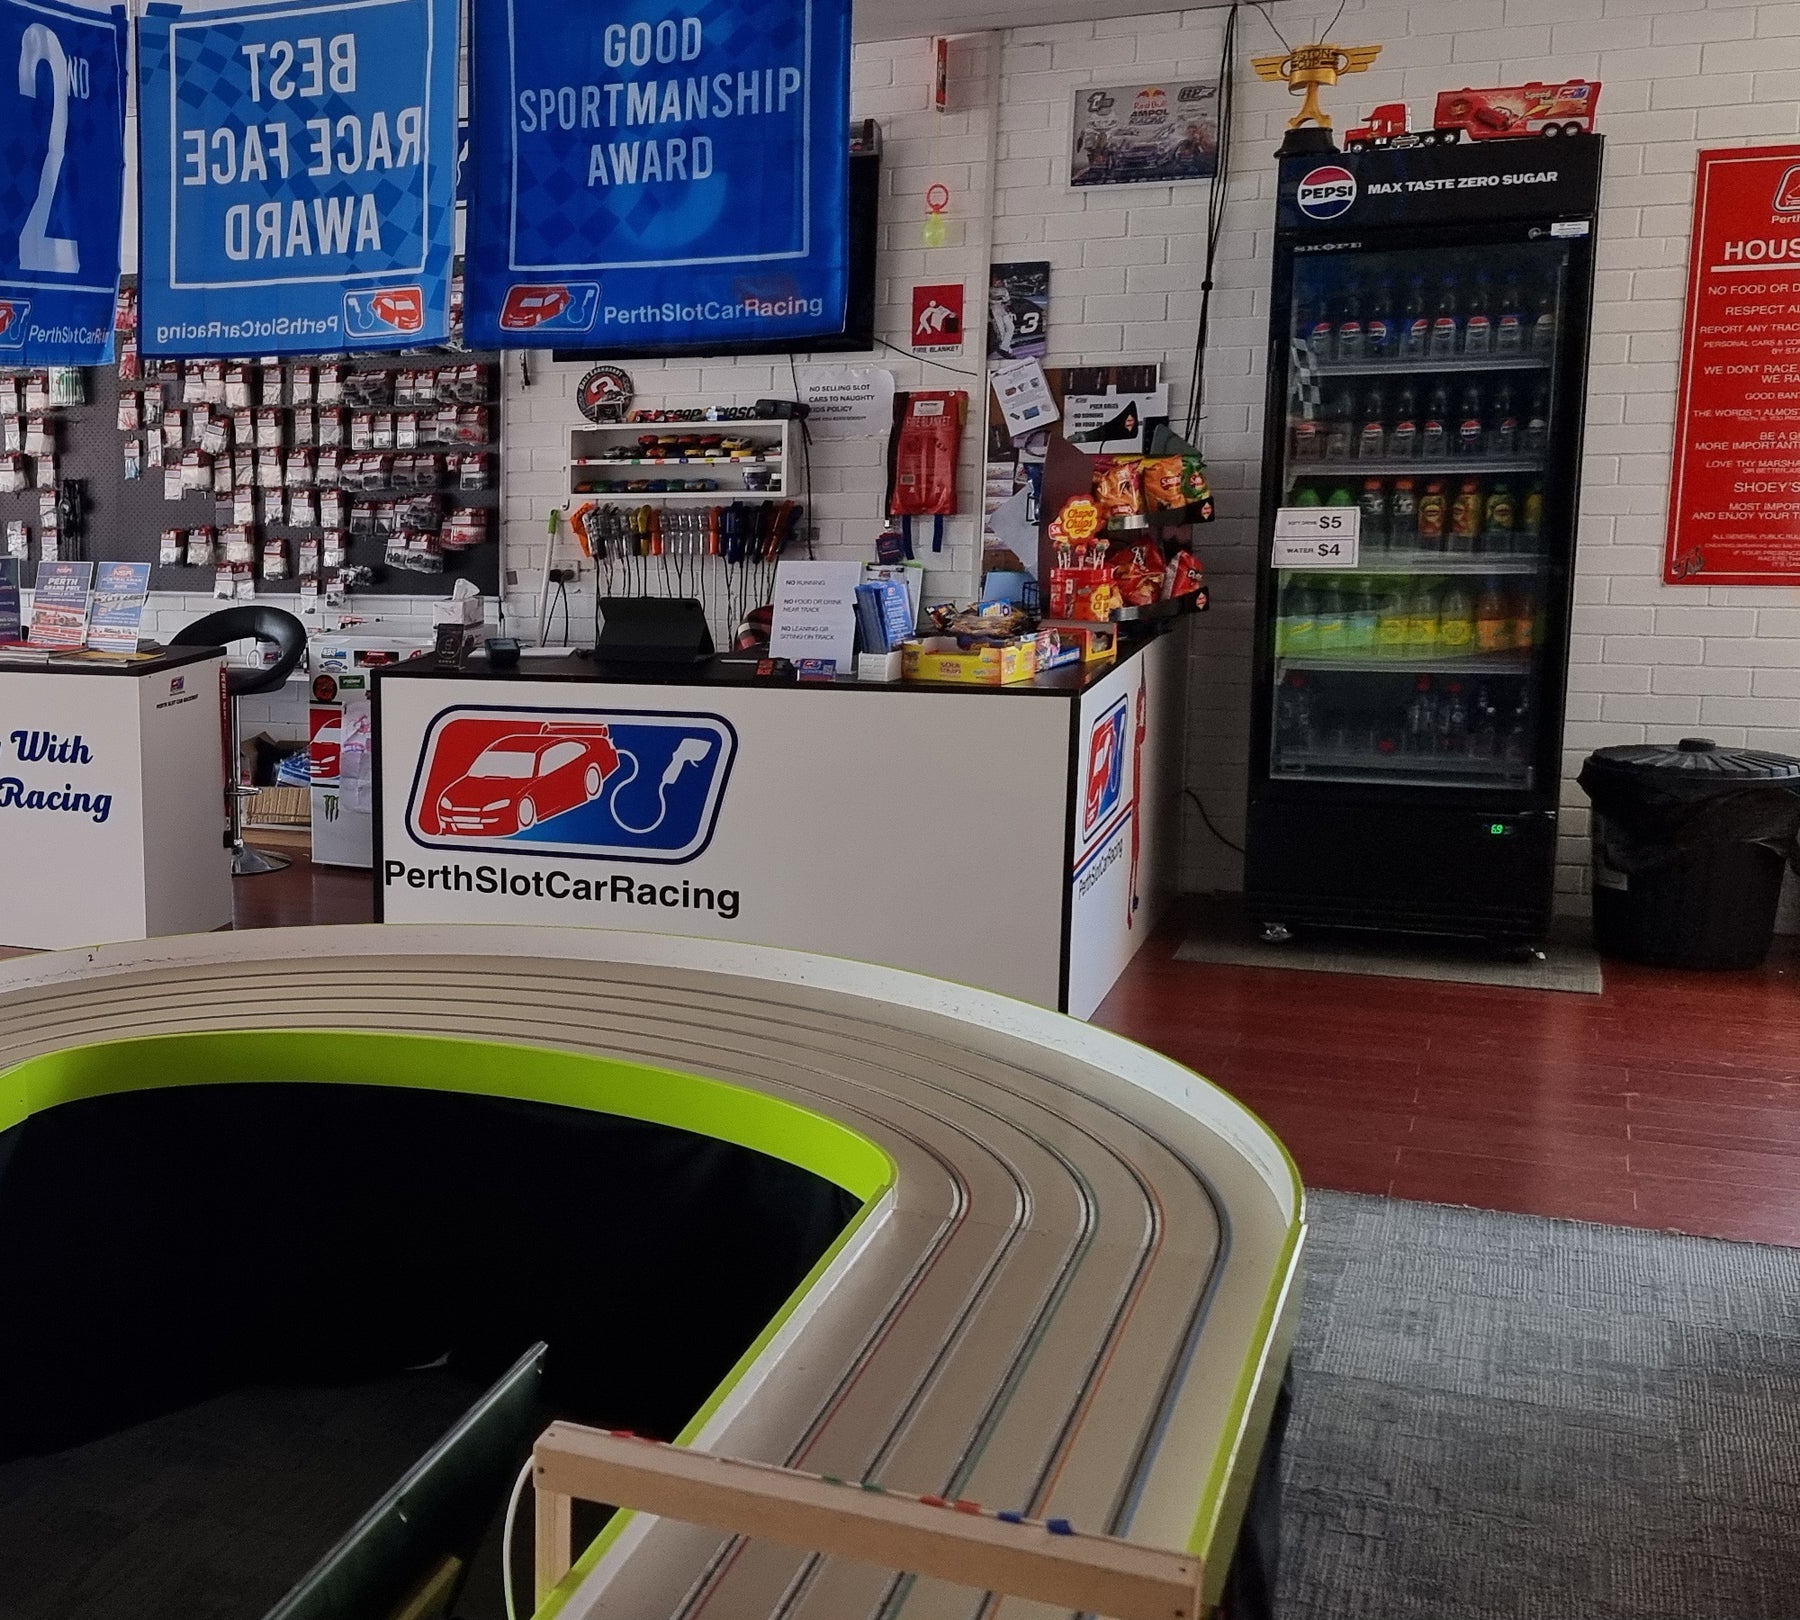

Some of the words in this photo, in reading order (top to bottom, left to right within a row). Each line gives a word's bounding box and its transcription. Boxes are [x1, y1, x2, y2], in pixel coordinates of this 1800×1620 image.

[604, 17, 701, 68] GOOD
[520, 66, 801, 133] SPORTMANSHIP
[1130, 109, 1169, 117] AMPOL
[588, 136, 713, 187] AWARD
[1368, 183, 1403, 195] MAX
[1405, 179, 1457, 192] TASTE
[1457, 175, 1500, 188] ZERO
[1502, 171, 1558, 185] SUGAR
[1301, 185, 1353, 199] PEPSI
[1708, 286, 1727, 295] NO
[1730, 285, 1766, 294] FOOD
[1770, 284, 1788, 293] OR
[604, 296, 823, 325] PerthSlotCarRacing
[1725, 305, 1785, 315] RESPECT
[1020, 312, 1039, 334] 3
[1700, 325, 1743, 334] REPORT
[1746, 324, 1767, 333] ANY
[930, 345, 959, 353] BLANKET
[1704, 366, 1723, 375] WE
[1726, 365, 1760, 374] DONT
[1764, 364, 1797, 373] RACE
[1761, 375, 1781, 383] WE
[822, 384, 851, 392] SELLING
[1744, 392, 1775, 400] GOOD
[1694, 409, 1712, 417] THE
[1760, 432, 1775, 440] BE
[1777, 431, 1786, 440] A
[1695, 442, 1729, 450] MORE
[1706, 460, 1733, 468] LOVE
[1736, 460, 1755, 468] THY
[1067, 509, 1094, 519] Chupa
[1692, 512, 1716, 520] AND
[1065, 518, 1094, 533] Chups
[1319, 516, 1342, 529] $5
[1318, 543, 1341, 556] $4
[47, 577, 79, 585] PERTH
[9, 730, 94, 765] With
[384, 859, 741, 920] PerthSlotCarRacing
